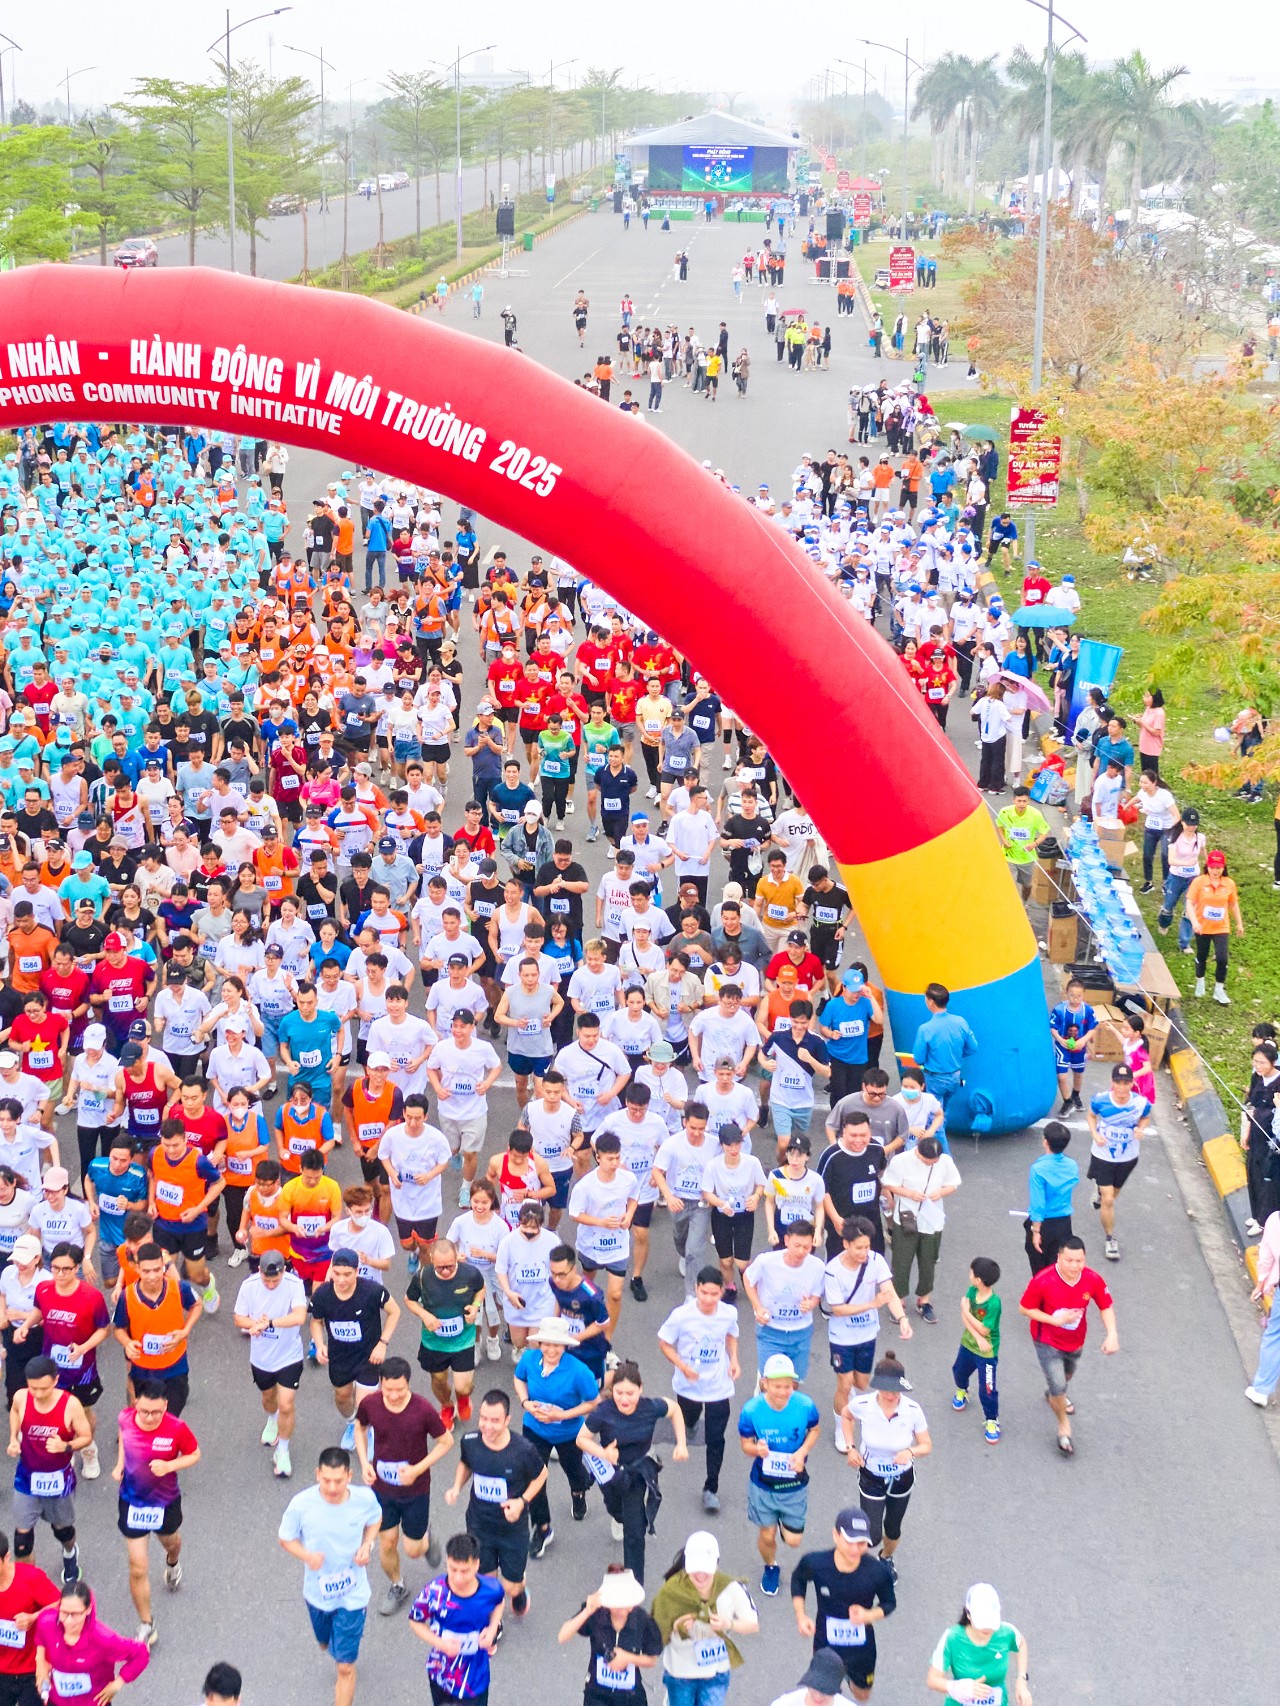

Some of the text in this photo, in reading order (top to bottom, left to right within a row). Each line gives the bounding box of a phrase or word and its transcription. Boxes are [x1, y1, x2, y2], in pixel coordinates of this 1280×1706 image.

[83, 382, 220, 411] COMMUNITY
[230, 394, 342, 435] INITIATIVE
[8, 334, 80, 378] NHÂN
[130, 334, 201, 379] HÀNH
[211, 344, 284, 399] ĐỘNG
[295, 358, 320, 400] VÌ
[324, 371, 381, 420] MÔI
[381, 390, 486, 463] TRƯỜNG
[489, 439, 562, 498] 2025
[784, 1077, 800, 1085] 0112
[362, 1127, 381, 1135] 0333
[631, 1160, 648, 1169] 1272
[681, 1180, 698, 1189] 1271
[46, 1219, 67, 1229] 0077
[599, 1238, 616, 1246] 1001
[520, 1269, 541, 1278] 1257
[779, 1308, 798, 1317] 1270
[334, 1327, 356, 1336] 0923
[770, 1460, 787, 1471] 195
[382, 1469, 398, 1479] 197
[36, 1478, 60, 1490] 0174
[132, 1511, 158, 1523] 0492
